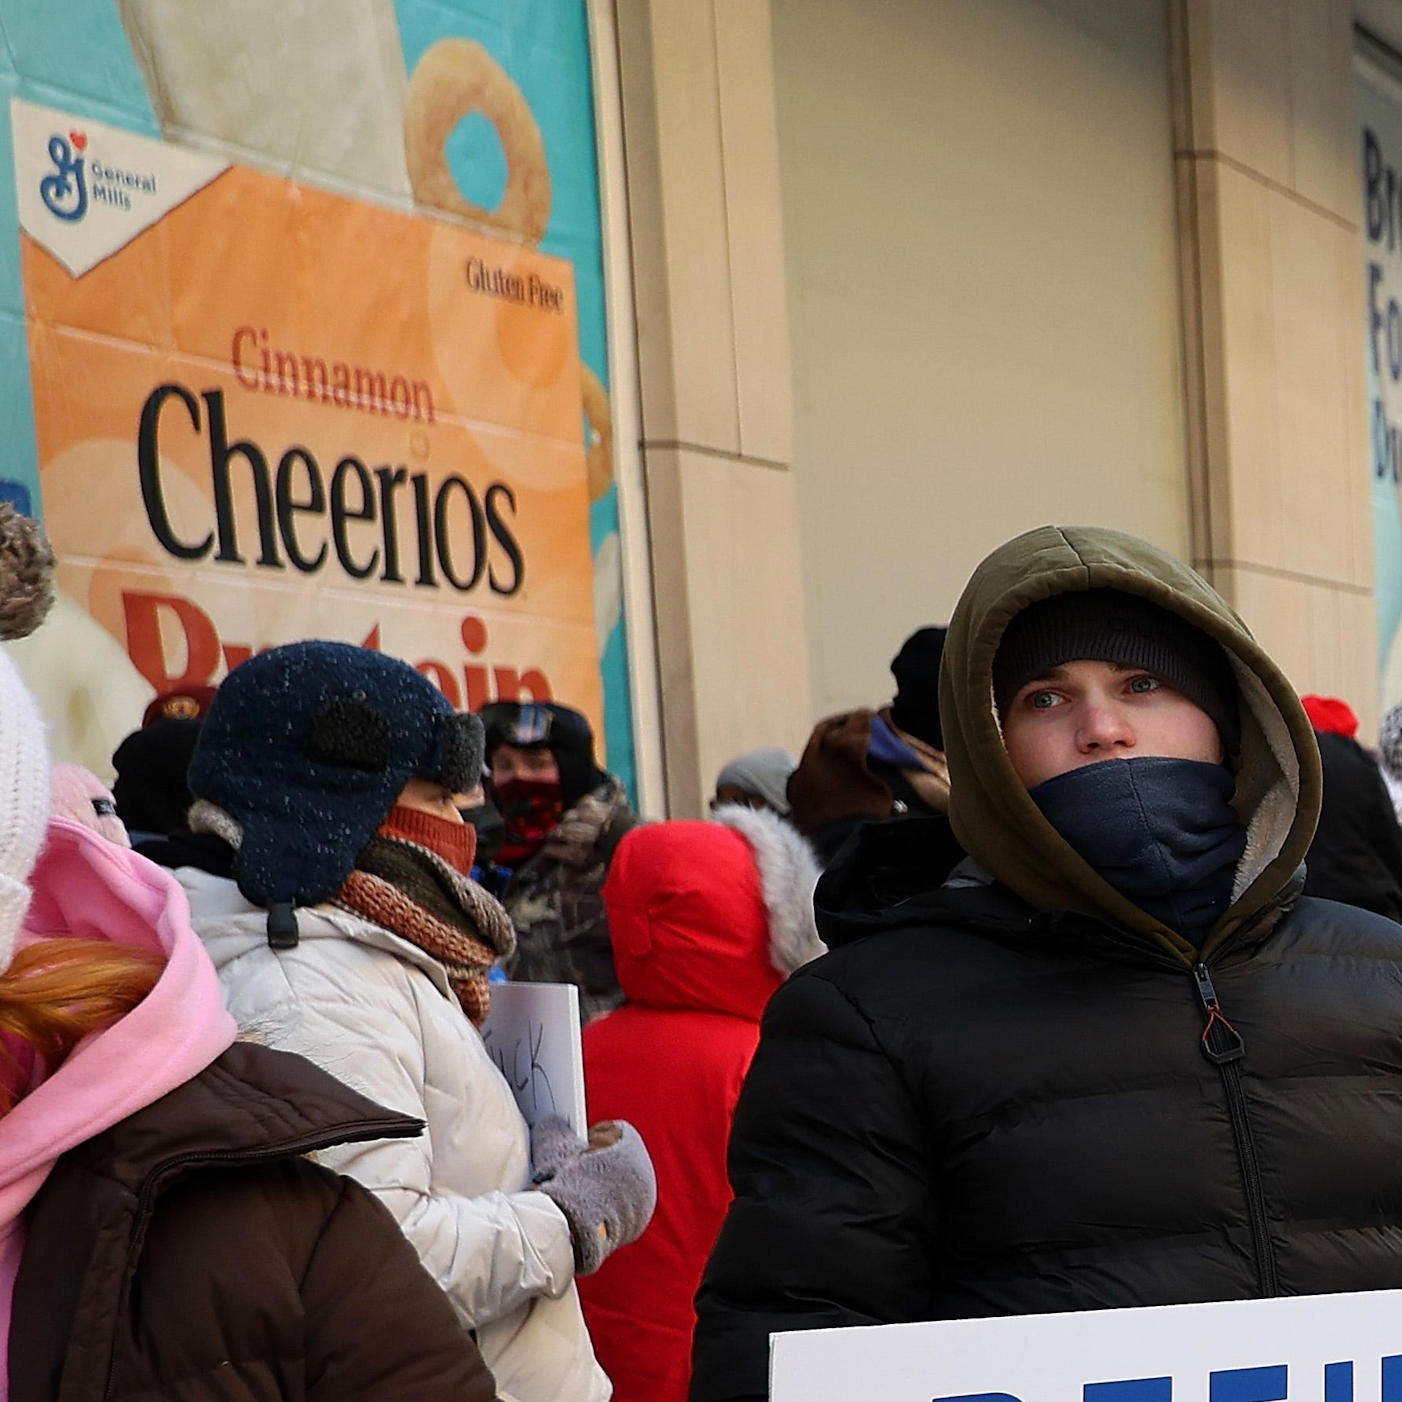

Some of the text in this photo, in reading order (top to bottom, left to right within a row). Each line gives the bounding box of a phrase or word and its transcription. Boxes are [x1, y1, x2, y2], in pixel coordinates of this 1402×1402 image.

[91, 161, 157, 194] General
[93, 184, 132, 210] Mills
[466, 257, 564, 315] Gluten Free
[231, 325, 437, 424] Cinnamon
[137, 381, 526, 598] Cheerios
